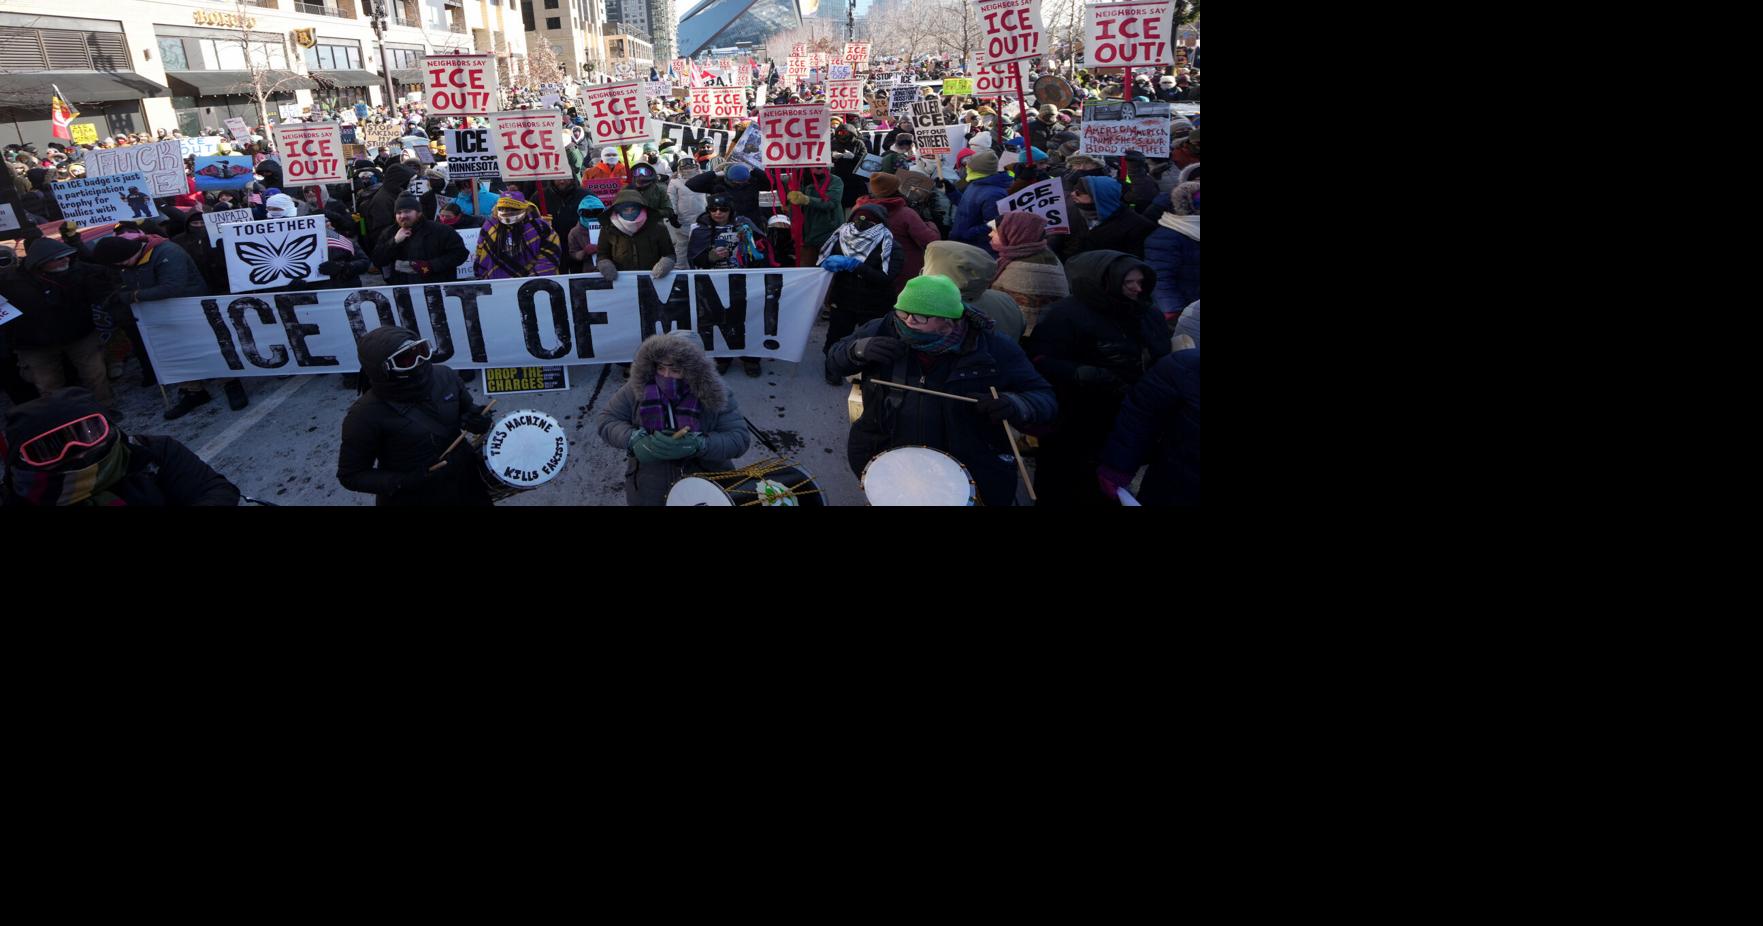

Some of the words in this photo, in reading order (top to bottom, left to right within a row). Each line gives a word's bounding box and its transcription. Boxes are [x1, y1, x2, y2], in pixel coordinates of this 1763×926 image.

[981, 1, 1020, 12] NEIGHBORS
[1096, 10, 1147, 18] NEIGHBORS
[984, 8, 1033, 35] ICE
[1095, 18, 1161, 40] ICE
[989, 32, 1039, 58] OUT!
[1095, 42, 1166, 63] OUT!
[429, 68, 485, 90] ICE
[901, 75, 911, 83] ICE
[976, 77, 1018, 90] OUT
[588, 90, 625, 100] NEIGHBORS
[693, 93, 710, 104] IC
[714, 93, 741, 105] ICE
[830, 87, 858, 98] ICE
[432, 91, 490, 111] OUT!
[591, 97, 640, 118] ICE
[831, 100, 859, 109] OUT!
[912, 101, 939, 115] KILLER
[693, 105, 710, 114] OU
[715, 105, 743, 117] OUT!
[763, 110, 807, 118] NEIGHBORS
[499, 122, 540, 130] NEIGHBORS
[596, 117, 645, 137] OUT!
[766, 118, 820, 139] ICE
[912, 114, 944, 128] ICE
[282, 132, 319, 140] NEIGHBORS
[455, 130, 488, 153] ICE
[501, 130, 555, 150] ICE
[918, 135, 949, 148] STREETS
[285, 139, 333, 158] ICE
[766, 141, 825, 161] OUT!
[1085, 144, 1118, 154] BLOOD
[95, 142, 178, 176] FUCK
[506, 152, 560, 171] OUT!
[288, 159, 339, 177] OUT!
[449, 162, 499, 172] MINNESOTA
[53, 183, 64, 191] An
[68, 180, 82, 188] ICE
[84, 176, 111, 186] badge
[112, 175, 120, 183] is
[122, 172, 140, 183] just
[65, 185, 125, 200] participation
[1009, 183, 1053, 211] ICE
[60, 199, 92, 211] trophy
[95, 196, 109, 204] for
[1038, 195, 1061, 209] OF
[63, 208, 93, 219] bullies
[96, 204, 117, 214] with
[89, 214, 116, 224] dicks.
[209, 209, 248, 223] UNPAID
[232, 218, 316, 236] TOGETHER
[200, 292, 339, 370] ICE
[344, 284, 493, 363] OUT
[517, 278, 613, 360] OF
[638, 273, 783, 351] MN!
[487, 367, 517, 380] DROP
[521, 366, 544, 378] THE
[488, 378, 545, 392] CHARGES
[491, 431, 507, 456] THIS
[505, 415, 553, 433] MACHINE
[504, 466, 539, 481] KILLS
[542, 436, 563, 475] FASCISTS
